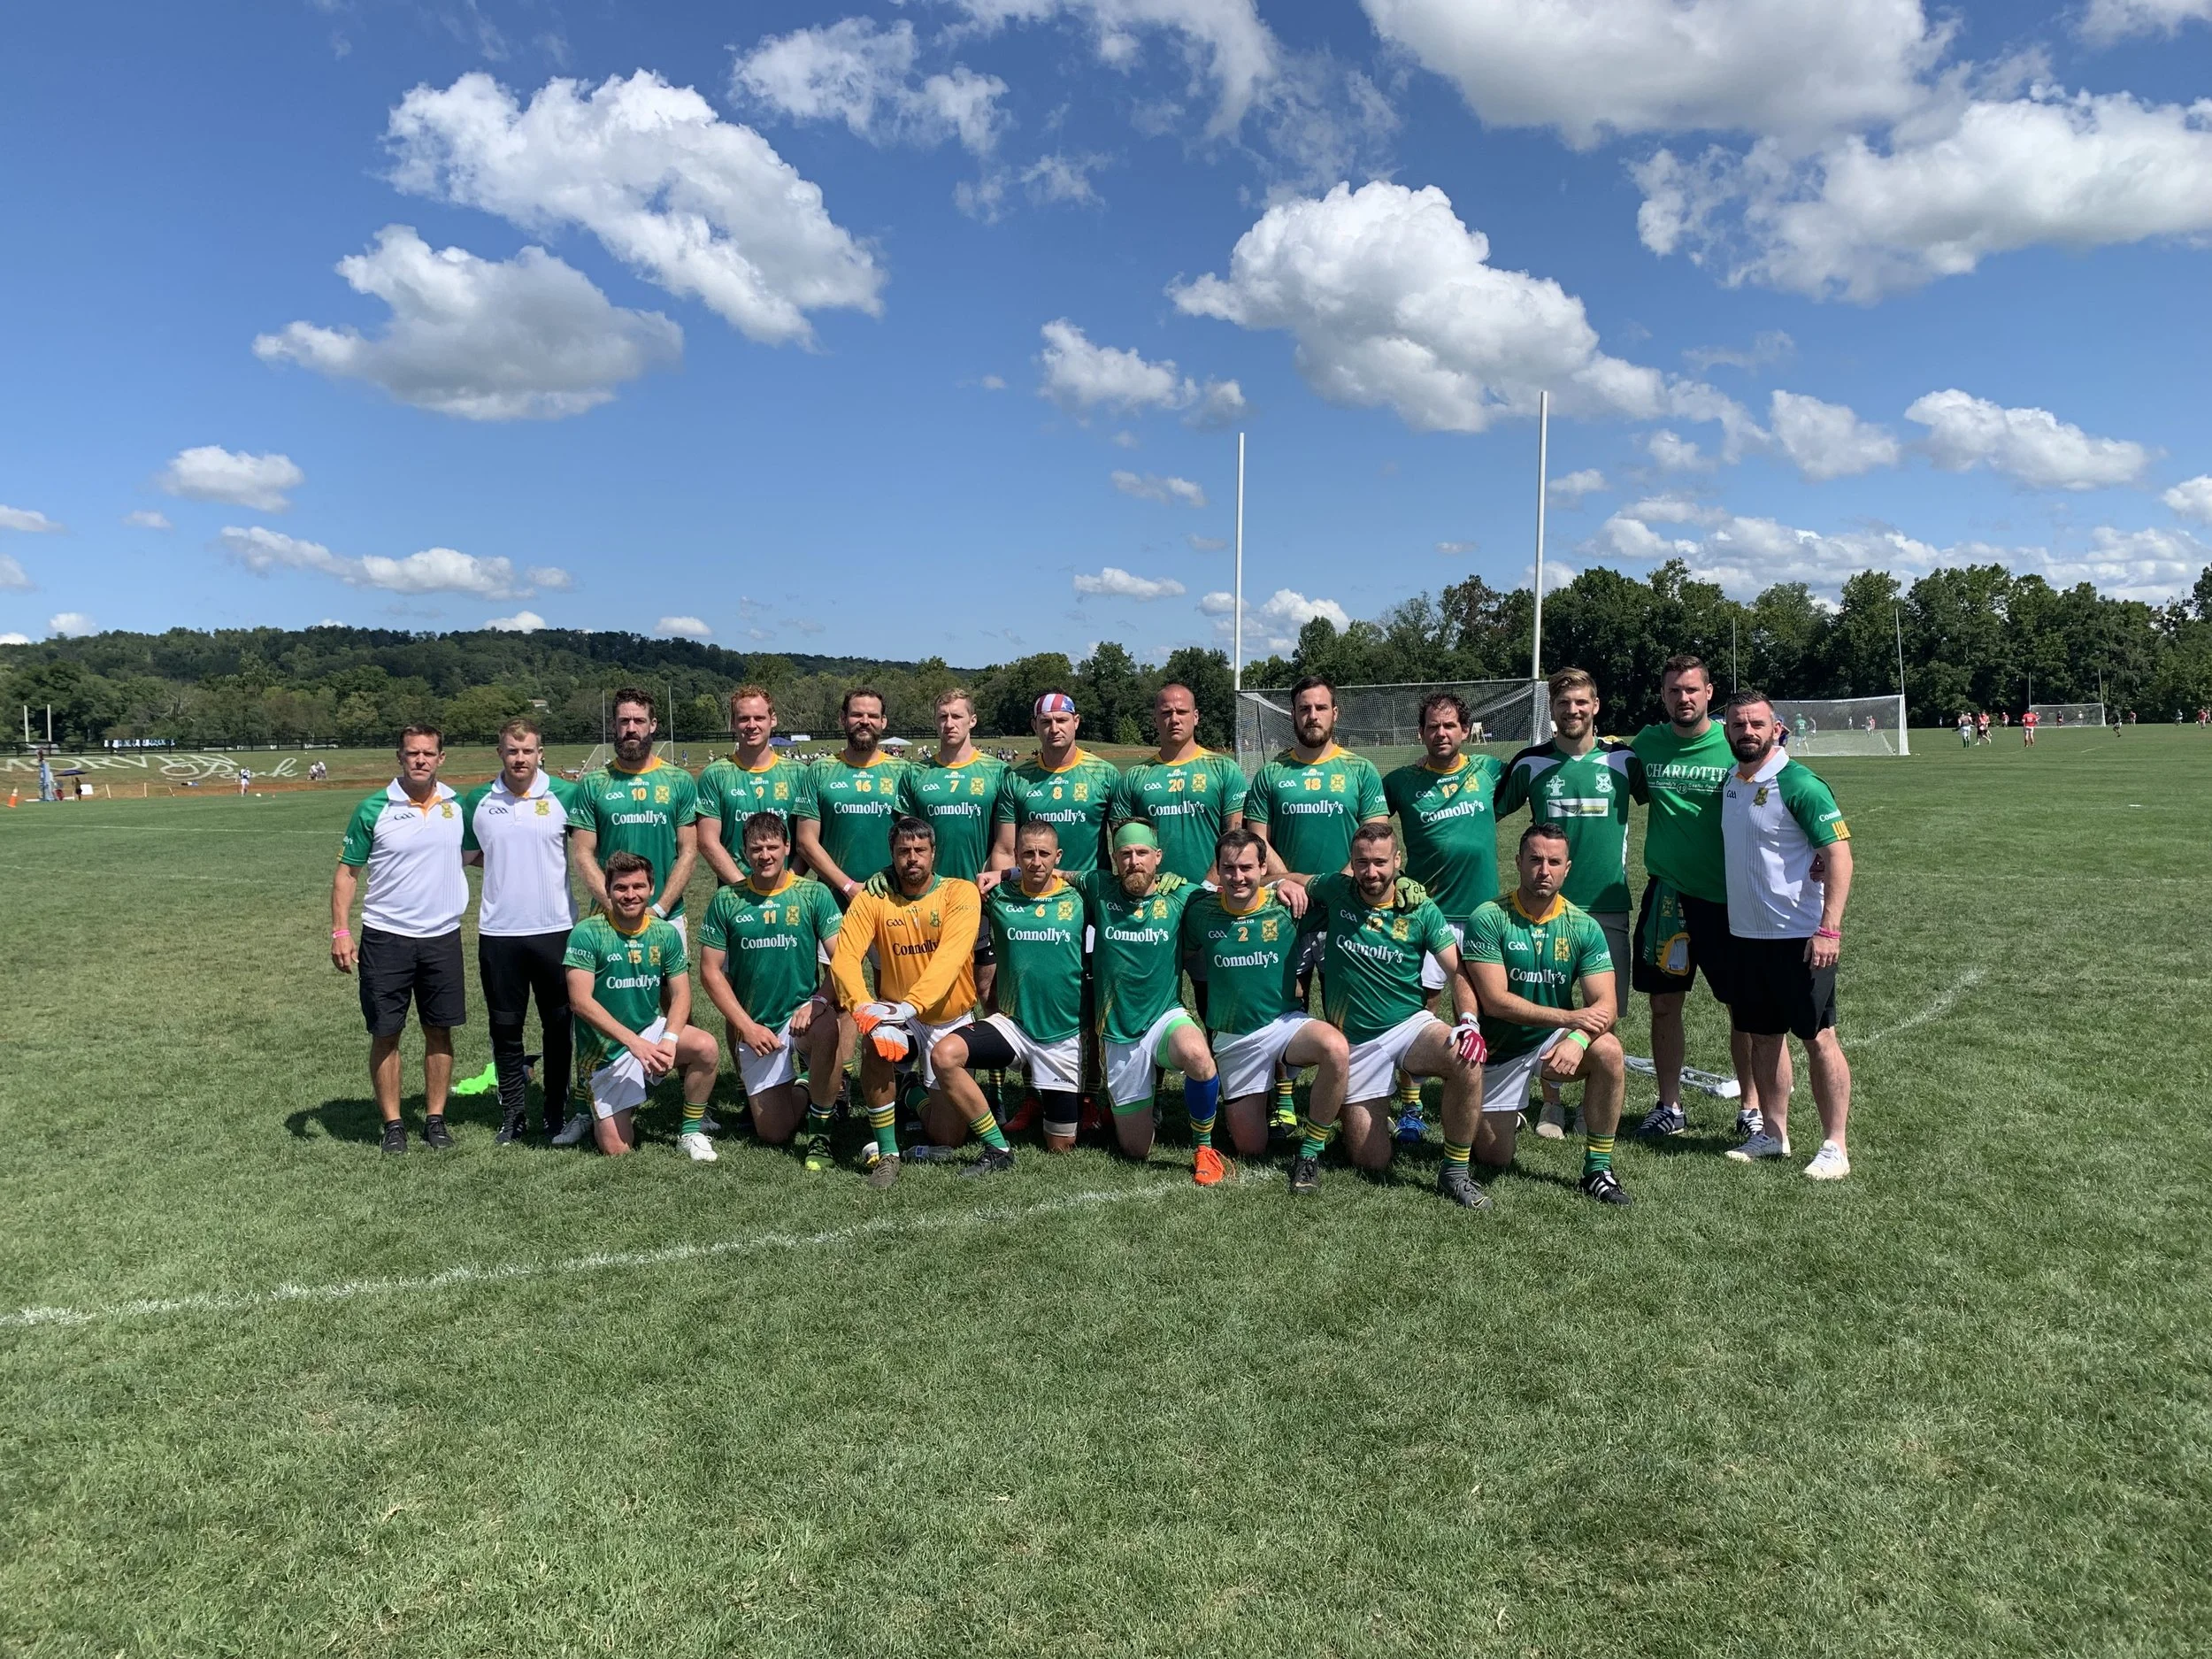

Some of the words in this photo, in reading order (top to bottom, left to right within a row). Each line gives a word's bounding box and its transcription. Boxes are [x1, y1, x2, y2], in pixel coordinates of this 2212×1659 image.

[1646, 763, 1728, 782] CHARLOTTE
[755, 786, 764, 800] 9
[855, 780, 872, 793] 16
[949, 780, 960, 793] 7
[1052, 786, 1063, 800] 8
[1167, 778, 1185, 793] 20
[631, 787, 647, 801] 10
[833, 801, 893, 818] Connolly's
[926, 802, 981, 818] Connolly's
[1148, 800, 1205, 817] Connolly's
[1281, 799, 1344, 817] Connolly's
[1419, 800, 1485, 824] Connolly's
[611, 810, 667, 827] Connolly's
[763, 910, 777, 925] 11
[1034, 903, 1046, 918] 6
[741, 933, 798, 950] Connolly's
[1006, 926, 1071, 945] Connolly's
[1104, 926, 1169, 946] Connolly's
[1237, 926, 1248, 942] 2
[893, 939, 940, 956] Connolly
[1335, 933, 1404, 964] Connolly's
[627, 949, 642, 964] 15
[1213, 950, 1279, 968] Connolly's
[606, 974, 661, 990] Connolly's
